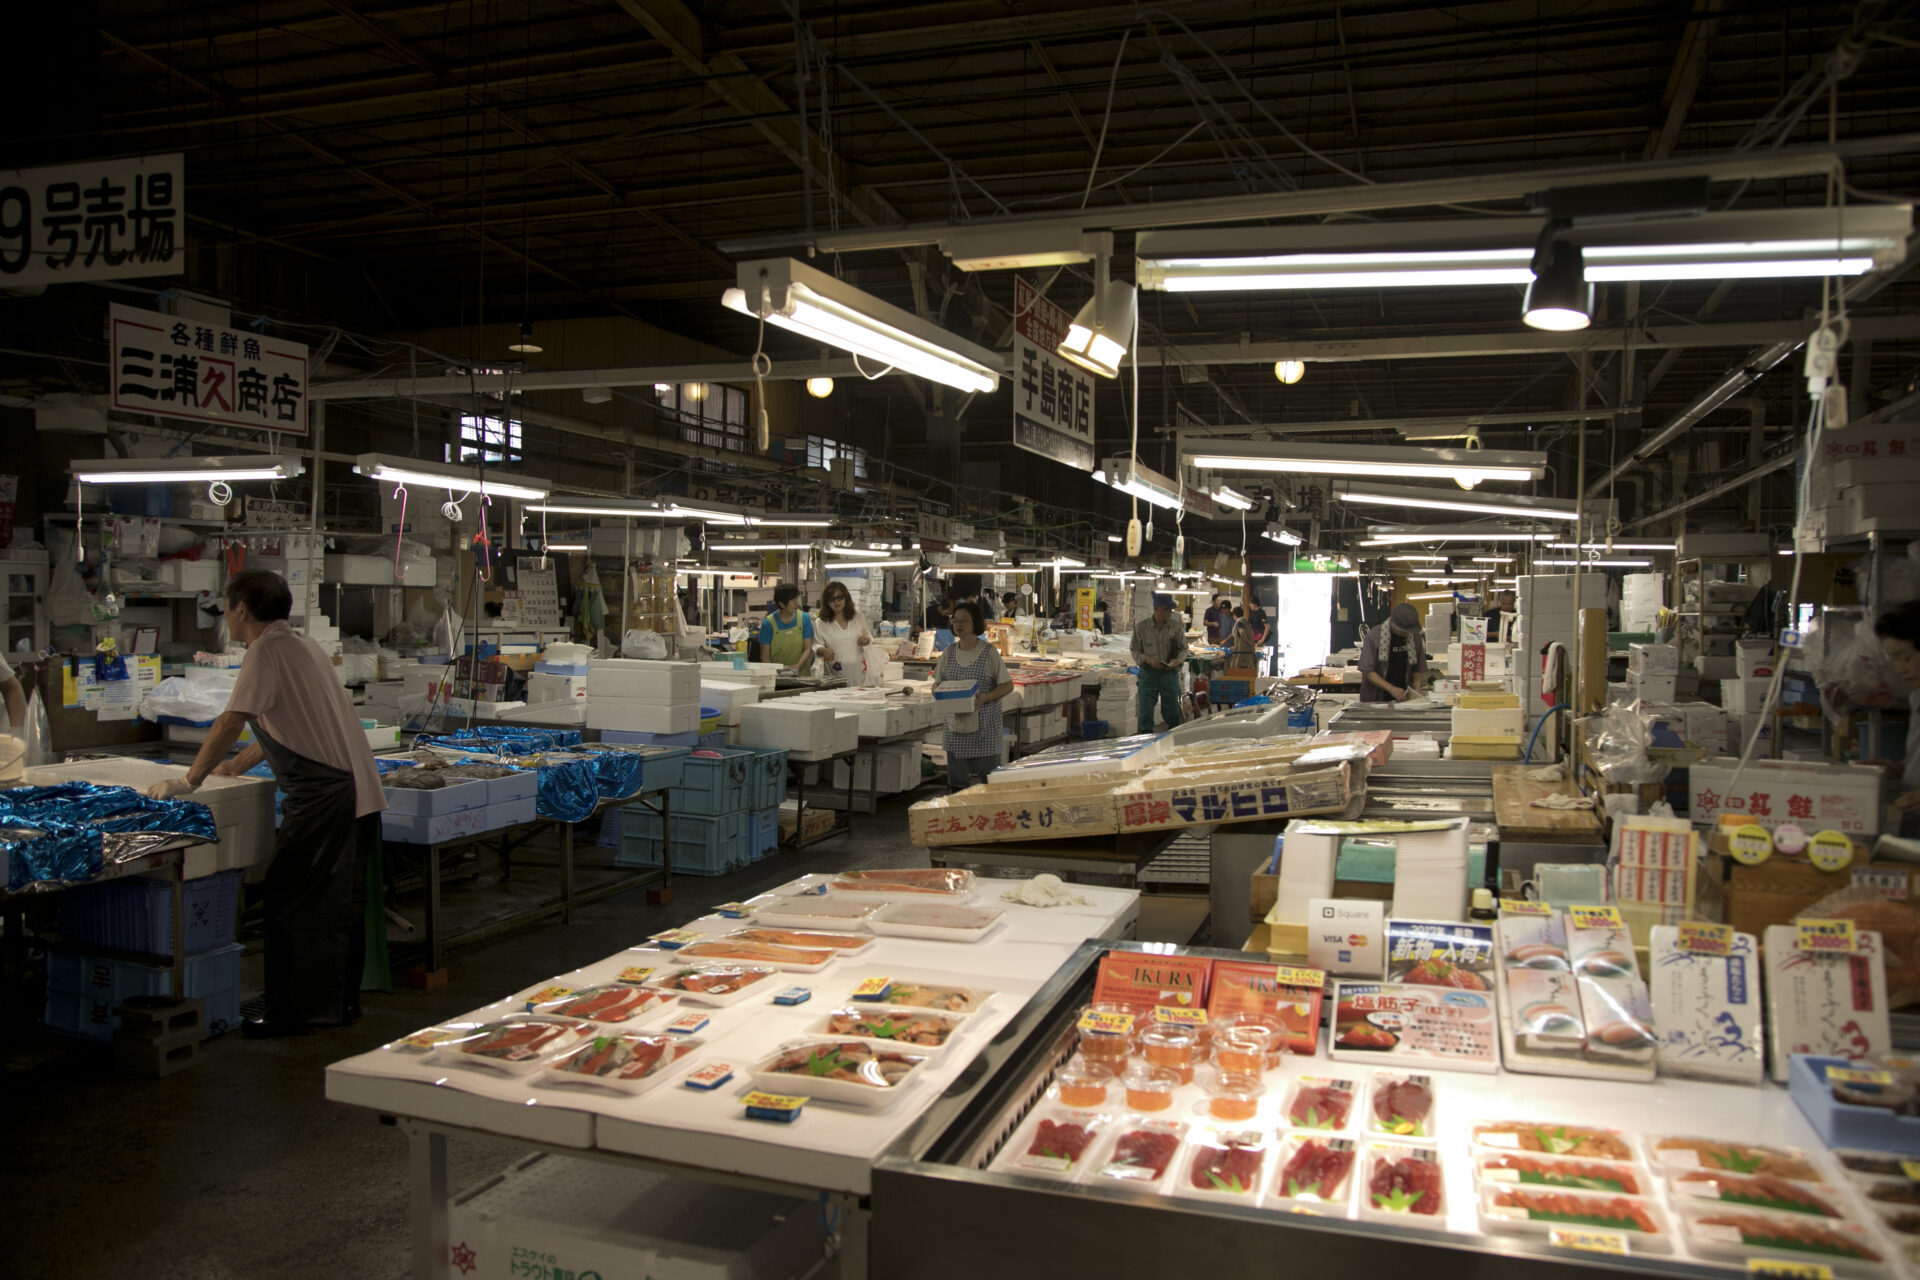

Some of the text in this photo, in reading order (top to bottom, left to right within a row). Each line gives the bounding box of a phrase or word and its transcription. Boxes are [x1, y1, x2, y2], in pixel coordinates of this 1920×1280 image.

[170, 321, 262, 362] 各種鮮魚
[118, 345, 304, 422] 三浦久商店
[1172, 786, 1289, 822] マルヒロ
[1336, 908, 1370, 919] Square
[1322, 934, 1344, 944] VISA
[1132, 967, 1193, 987] IKURA
